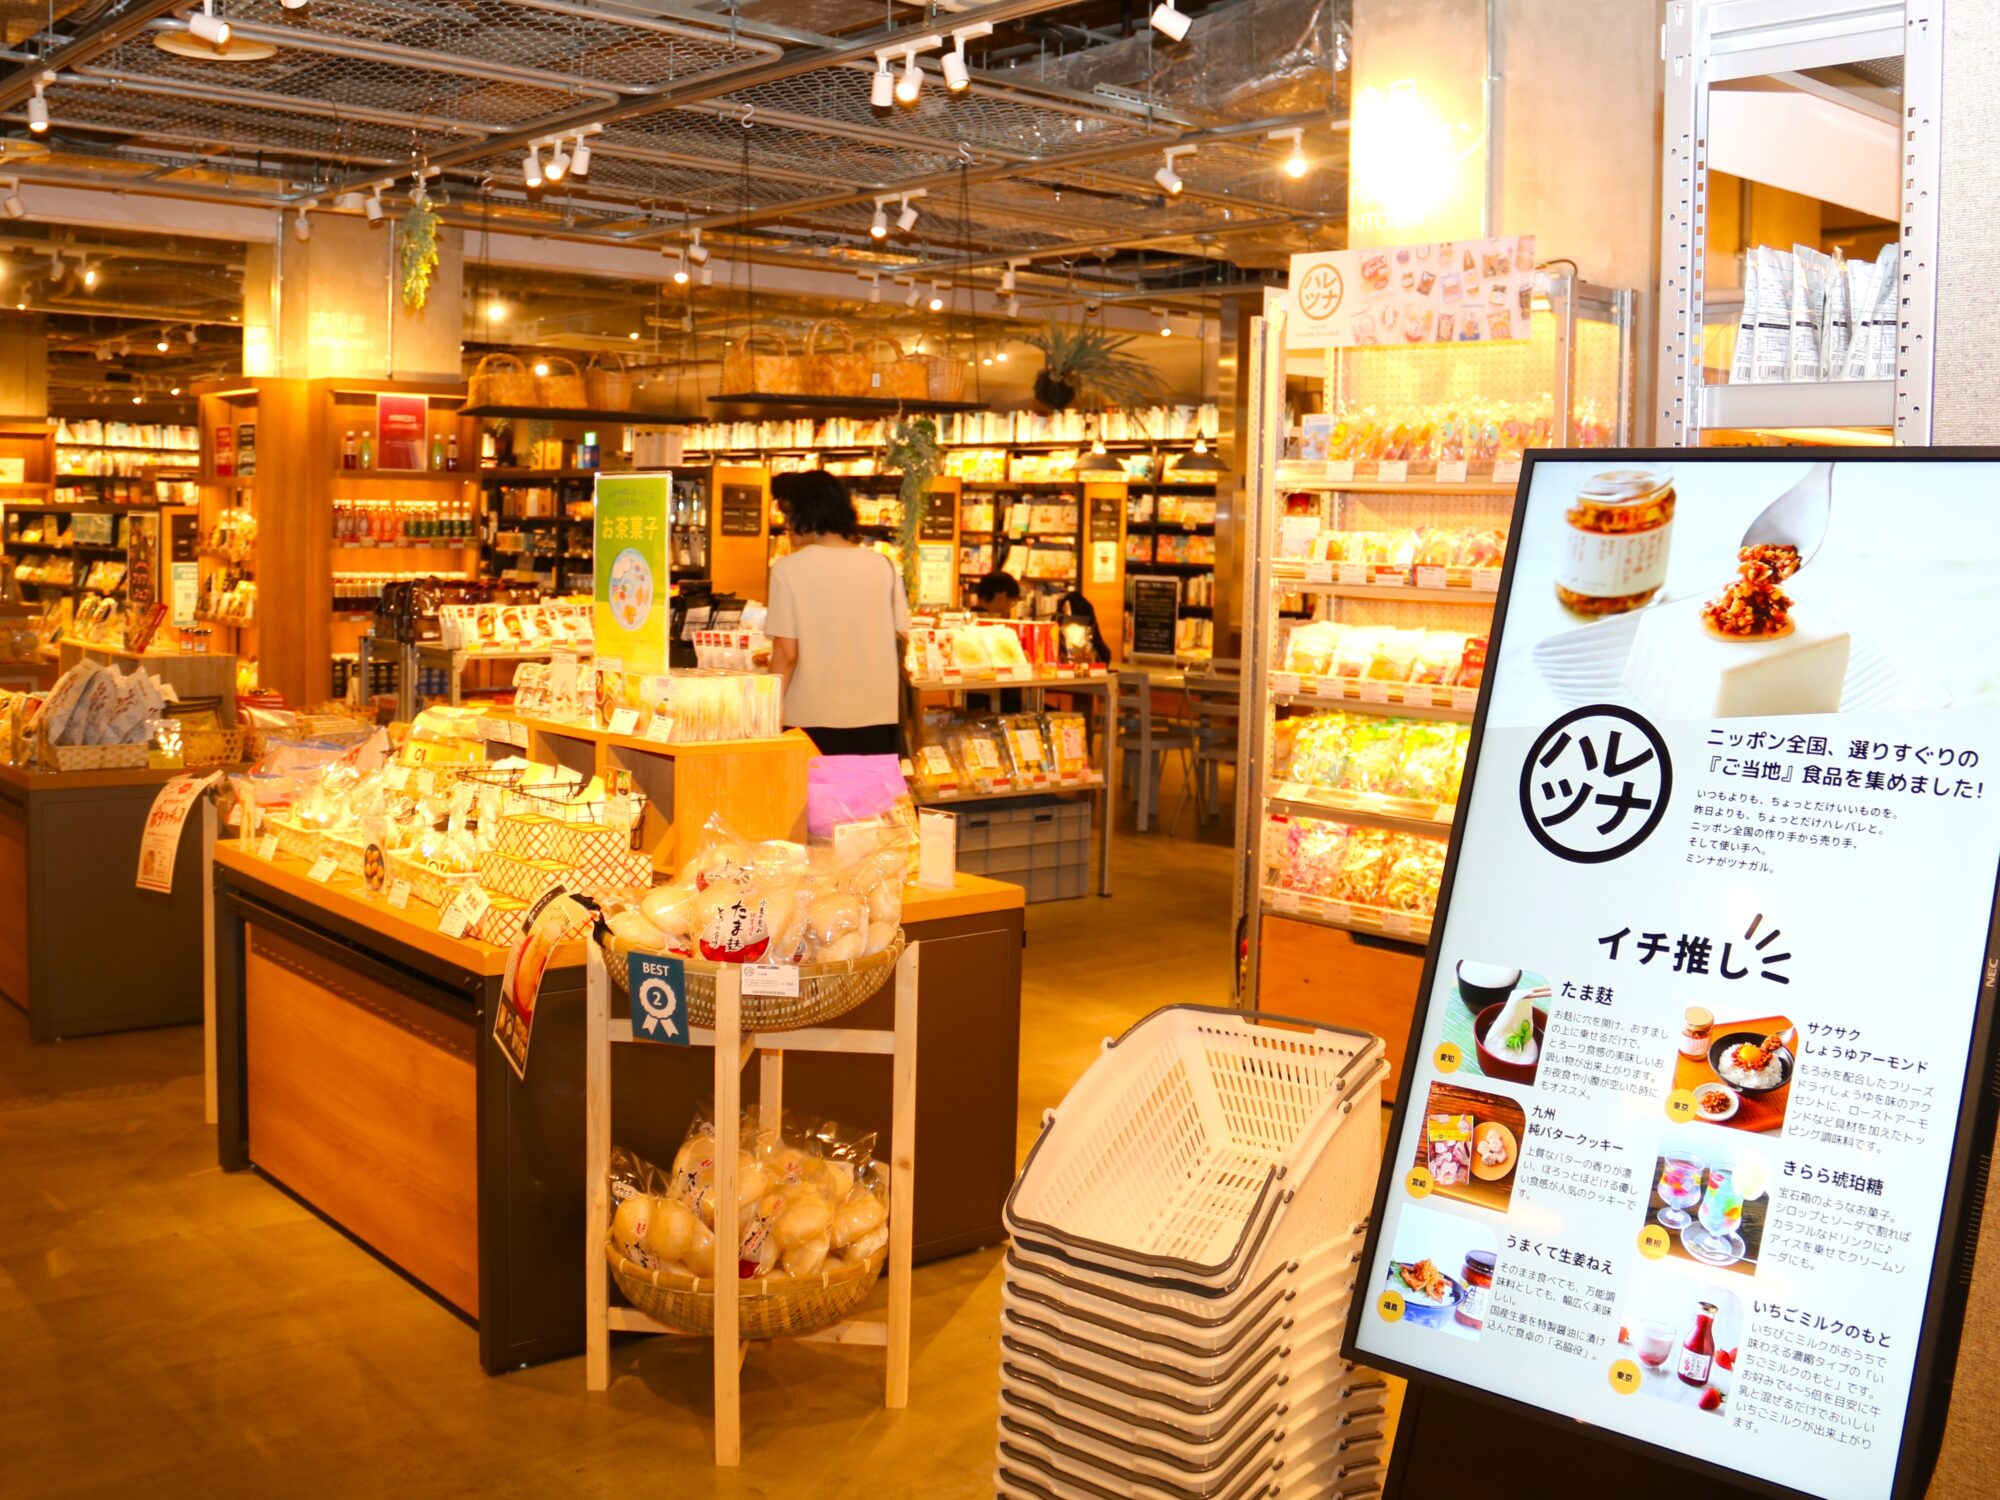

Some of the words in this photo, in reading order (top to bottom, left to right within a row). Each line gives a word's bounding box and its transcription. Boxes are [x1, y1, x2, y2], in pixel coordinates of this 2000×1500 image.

[1350, 211, 1425, 232] KITC
[1303, 269, 1337, 289] ハレ
[1305, 290, 1338, 310] ツナ
[602, 516, 659, 540] お茶菓子
[1539, 730, 1655, 771] ハレ
[1707, 728, 1979, 769] ニッポン全国、選りすぐりの
[1540, 779, 1654, 836] ツナ
[1693, 804, 1885, 836] 昨日よりも、ちょっとだけハレバレと。
[1697, 788, 1900, 820] いつもよりも、ちょっとだけいいものを。
[1688, 837, 1767, 857] そして使い手へ。
[1690, 821, 1859, 850] ニッポン全国の作り手から売り手、
[1685, 854, 1775, 875] ミンナがツナガル。
[642, 962, 670, 976] BEST
[1597, 926, 1750, 981] イチ推し
[1985, 958, 1998, 987] NEC
[652, 991, 662, 1006] 2
[1551, 1024, 1641, 1049] の上に乗せるだけで、
[1808, 1022, 1861, 1041] サクサク
[1440, 1052, 1455, 1064] 愛知
[1545, 1052, 1657, 1083] 吸い物が出来上がります。
[1549, 1038, 1664, 1069] とろーり食感の美味しいお
[1804, 1041, 1929, 1074] しょうゆアーモンド
[1540, 1081, 1591, 1100] もオススメ。
[1543, 1066, 1659, 1098] お夜食や小腹が空いた時に
[1797, 1080, 1931, 1113] ドライしょうゆを味のアク
[1800, 1064, 1936, 1098] もろみを配合したフリーズ
[1532, 1105, 1556, 1121] 九州
[1673, 1101, 1689, 1113] 東京
[1794, 1095, 1929, 1129] セントに、ローストアーモ
[1528, 1123, 1623, 1152] 純バタークッキー
[1788, 1125, 1882, 1154] ピング調味料です。
[1791, 1110, 1925, 1145] ンドなど具材を加えたトッ
[1523, 1161, 1638, 1196] い、ほろっとほどける優し
[1526, 1146, 1633, 1179] 上質なバターの香りが漂
[1783, 1160, 1885, 1196] きらら琥珀糖
[1518, 1188, 1531, 1200] す。
[1520, 1175, 1636, 1210] い食感が人気のクッキーで
[1778, 1187, 1896, 1224] 宝石箱のようなお菓子。
[1775, 1203, 1912, 1243] シロップとソーダで割れば
[1506, 1234, 1613, 1275] うまくて生姜ねえ
[1767, 1251, 1816, 1271] ーダにも。
[1769, 1234, 1906, 1274] アイスを乗せてクリームソ
[1494, 1291, 1516, 1306] しい。
[1496, 1276, 1612, 1317] 味料としても、幅広く美味
[1500, 1262, 1616, 1303] そのまま食べても、万能調
[1487, 1319, 1597, 1361] 込んだ食卓の「名脇役」。
[1752, 1299, 1893, 1349] いちごミルクのもと
[1748, 1337, 1885, 1384] 味わえる濃縮タイプの「い
[1751, 1322, 1888, 1369] いちびこミルクがおうちで
[1616, 1370, 1633, 1383] 東京
[1746, 1354, 1874, 1400] ちごミルクのもと」です。
[1738, 1385, 1876, 1433] 乳と混ぜるだけでおいしい
[1733, 1417, 1759, 1434] ます。
[1735, 1401, 1872, 1450] いちごミルクが出来上がり
